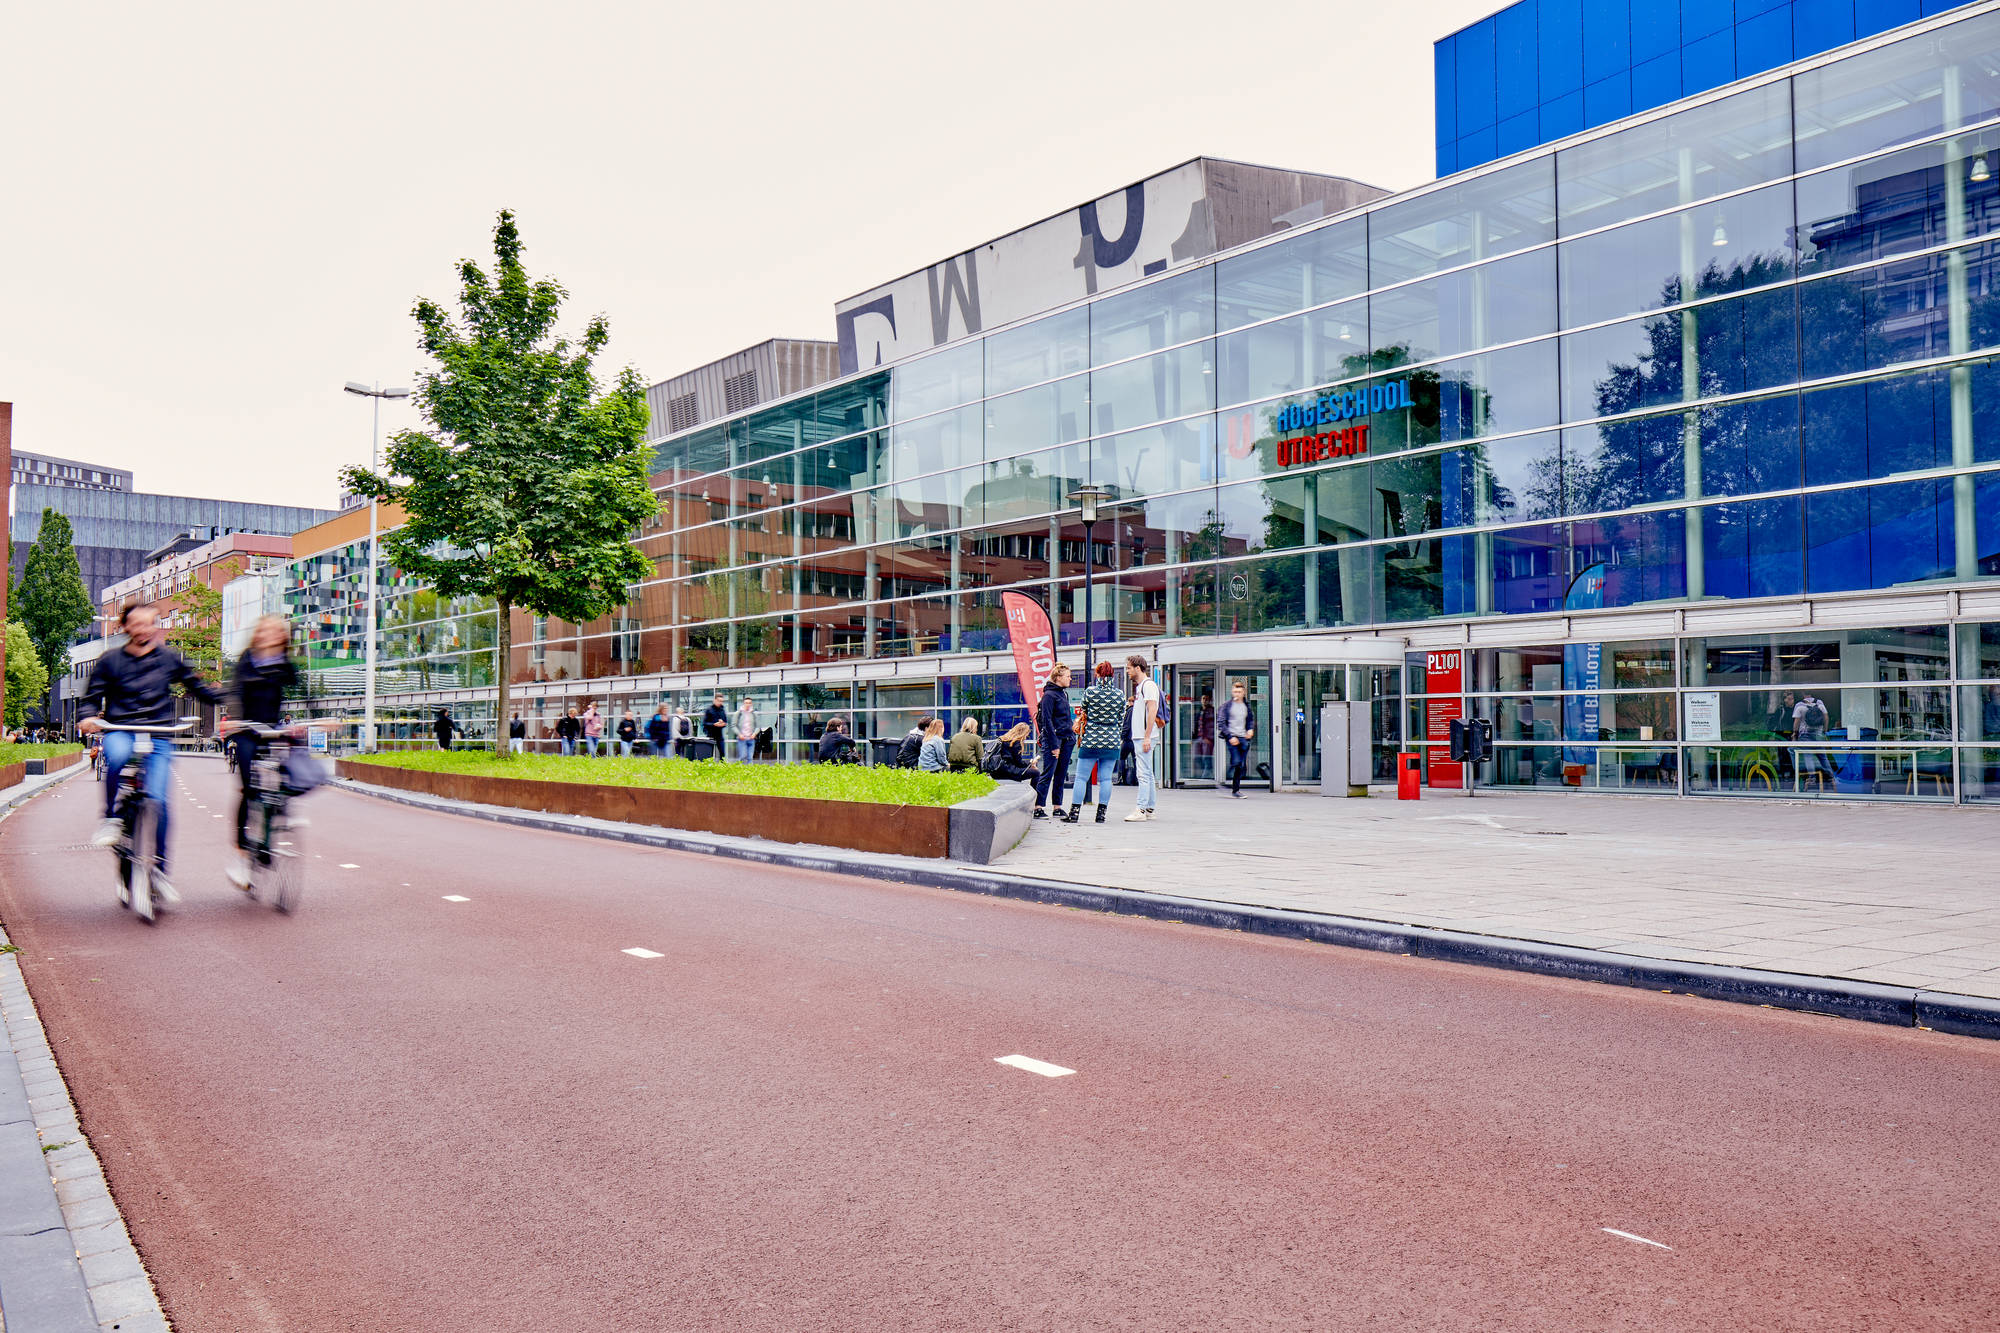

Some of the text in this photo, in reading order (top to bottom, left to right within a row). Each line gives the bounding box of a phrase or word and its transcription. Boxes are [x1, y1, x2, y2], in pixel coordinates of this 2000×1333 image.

[1277, 379, 1416, 432] HOGESCHOOL
[1277, 425, 1369, 467] UTRECHT
[1428, 653, 1459, 670] PL101
[1585, 643, 1600, 733] HU BIBLIOTH
